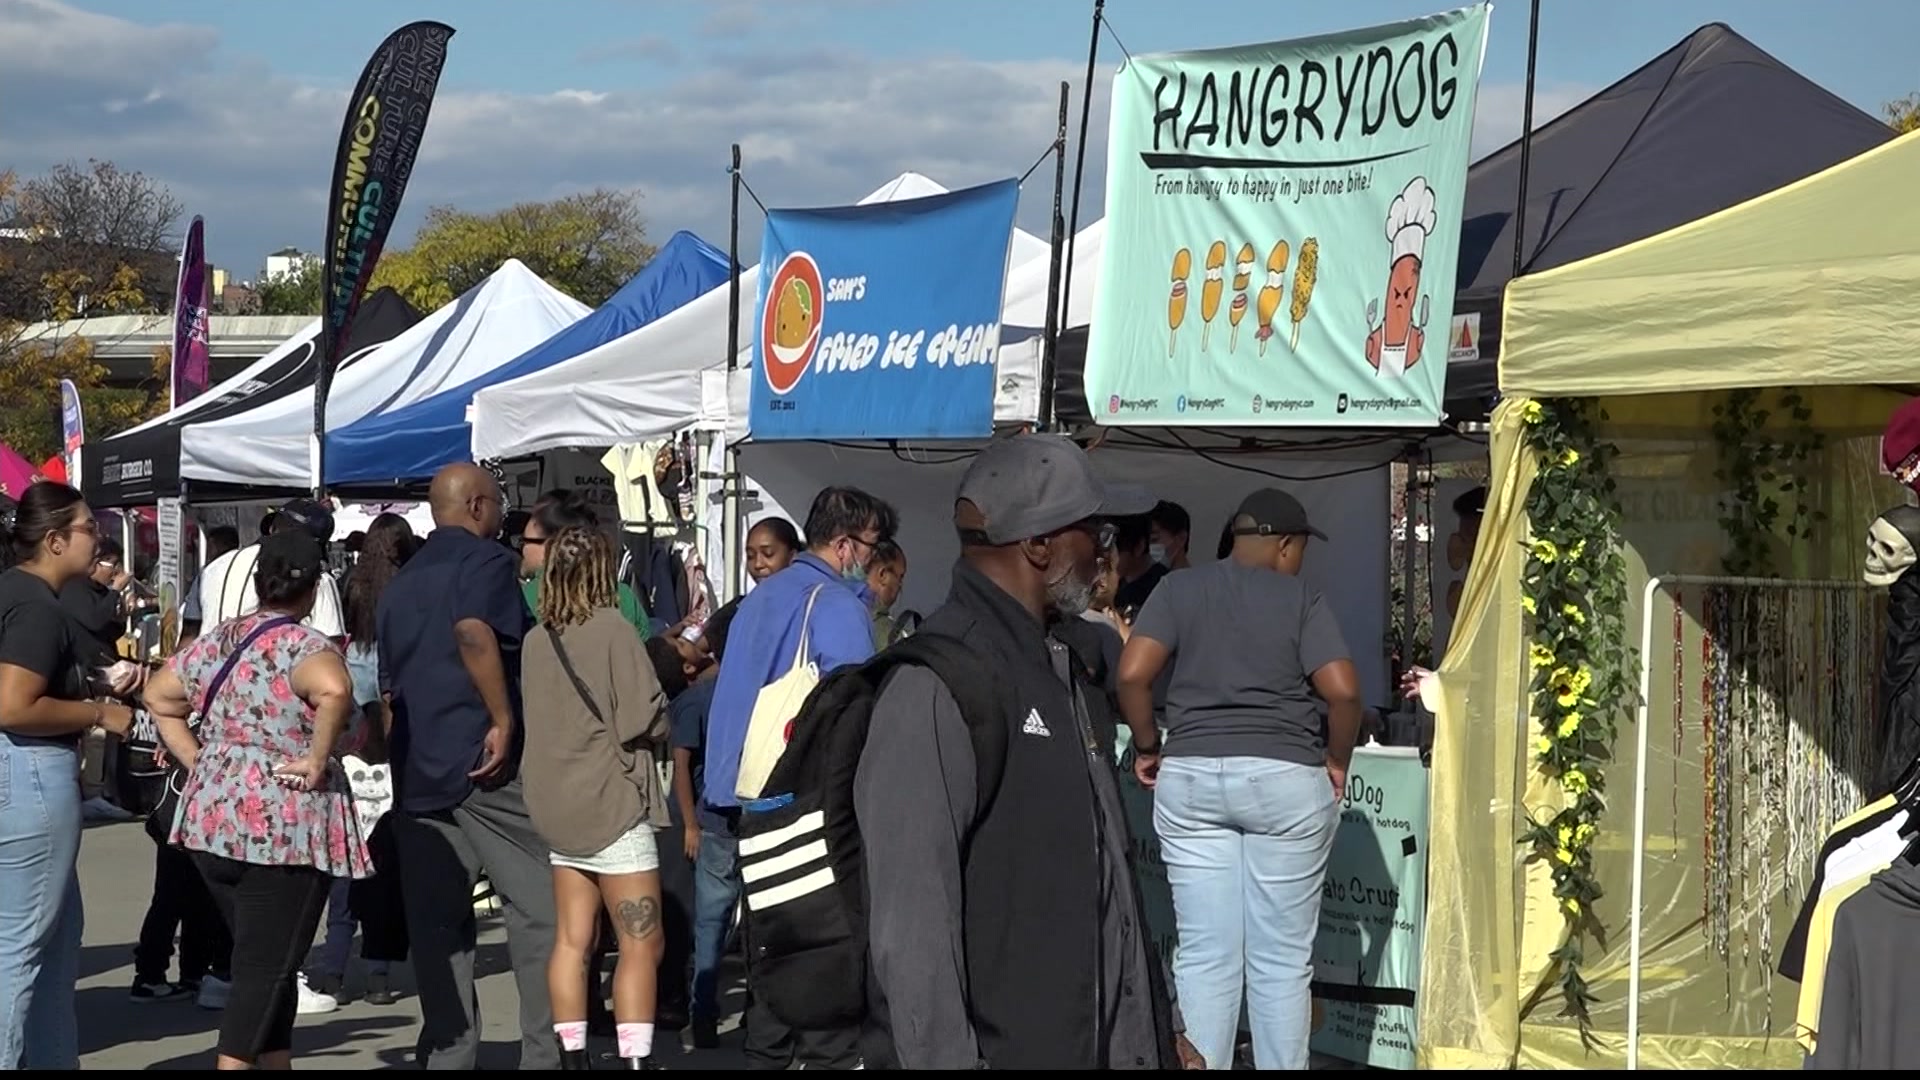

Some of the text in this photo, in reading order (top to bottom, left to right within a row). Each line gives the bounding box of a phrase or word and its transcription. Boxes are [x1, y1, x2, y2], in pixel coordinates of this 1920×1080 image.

[1152, 32, 1458, 150] HANGRYDOG
[1154, 167, 1374, 203] From hangry to happy in just one bite!
[826, 275, 867, 302] SAM'S
[926, 321, 1001, 369] CREAM
